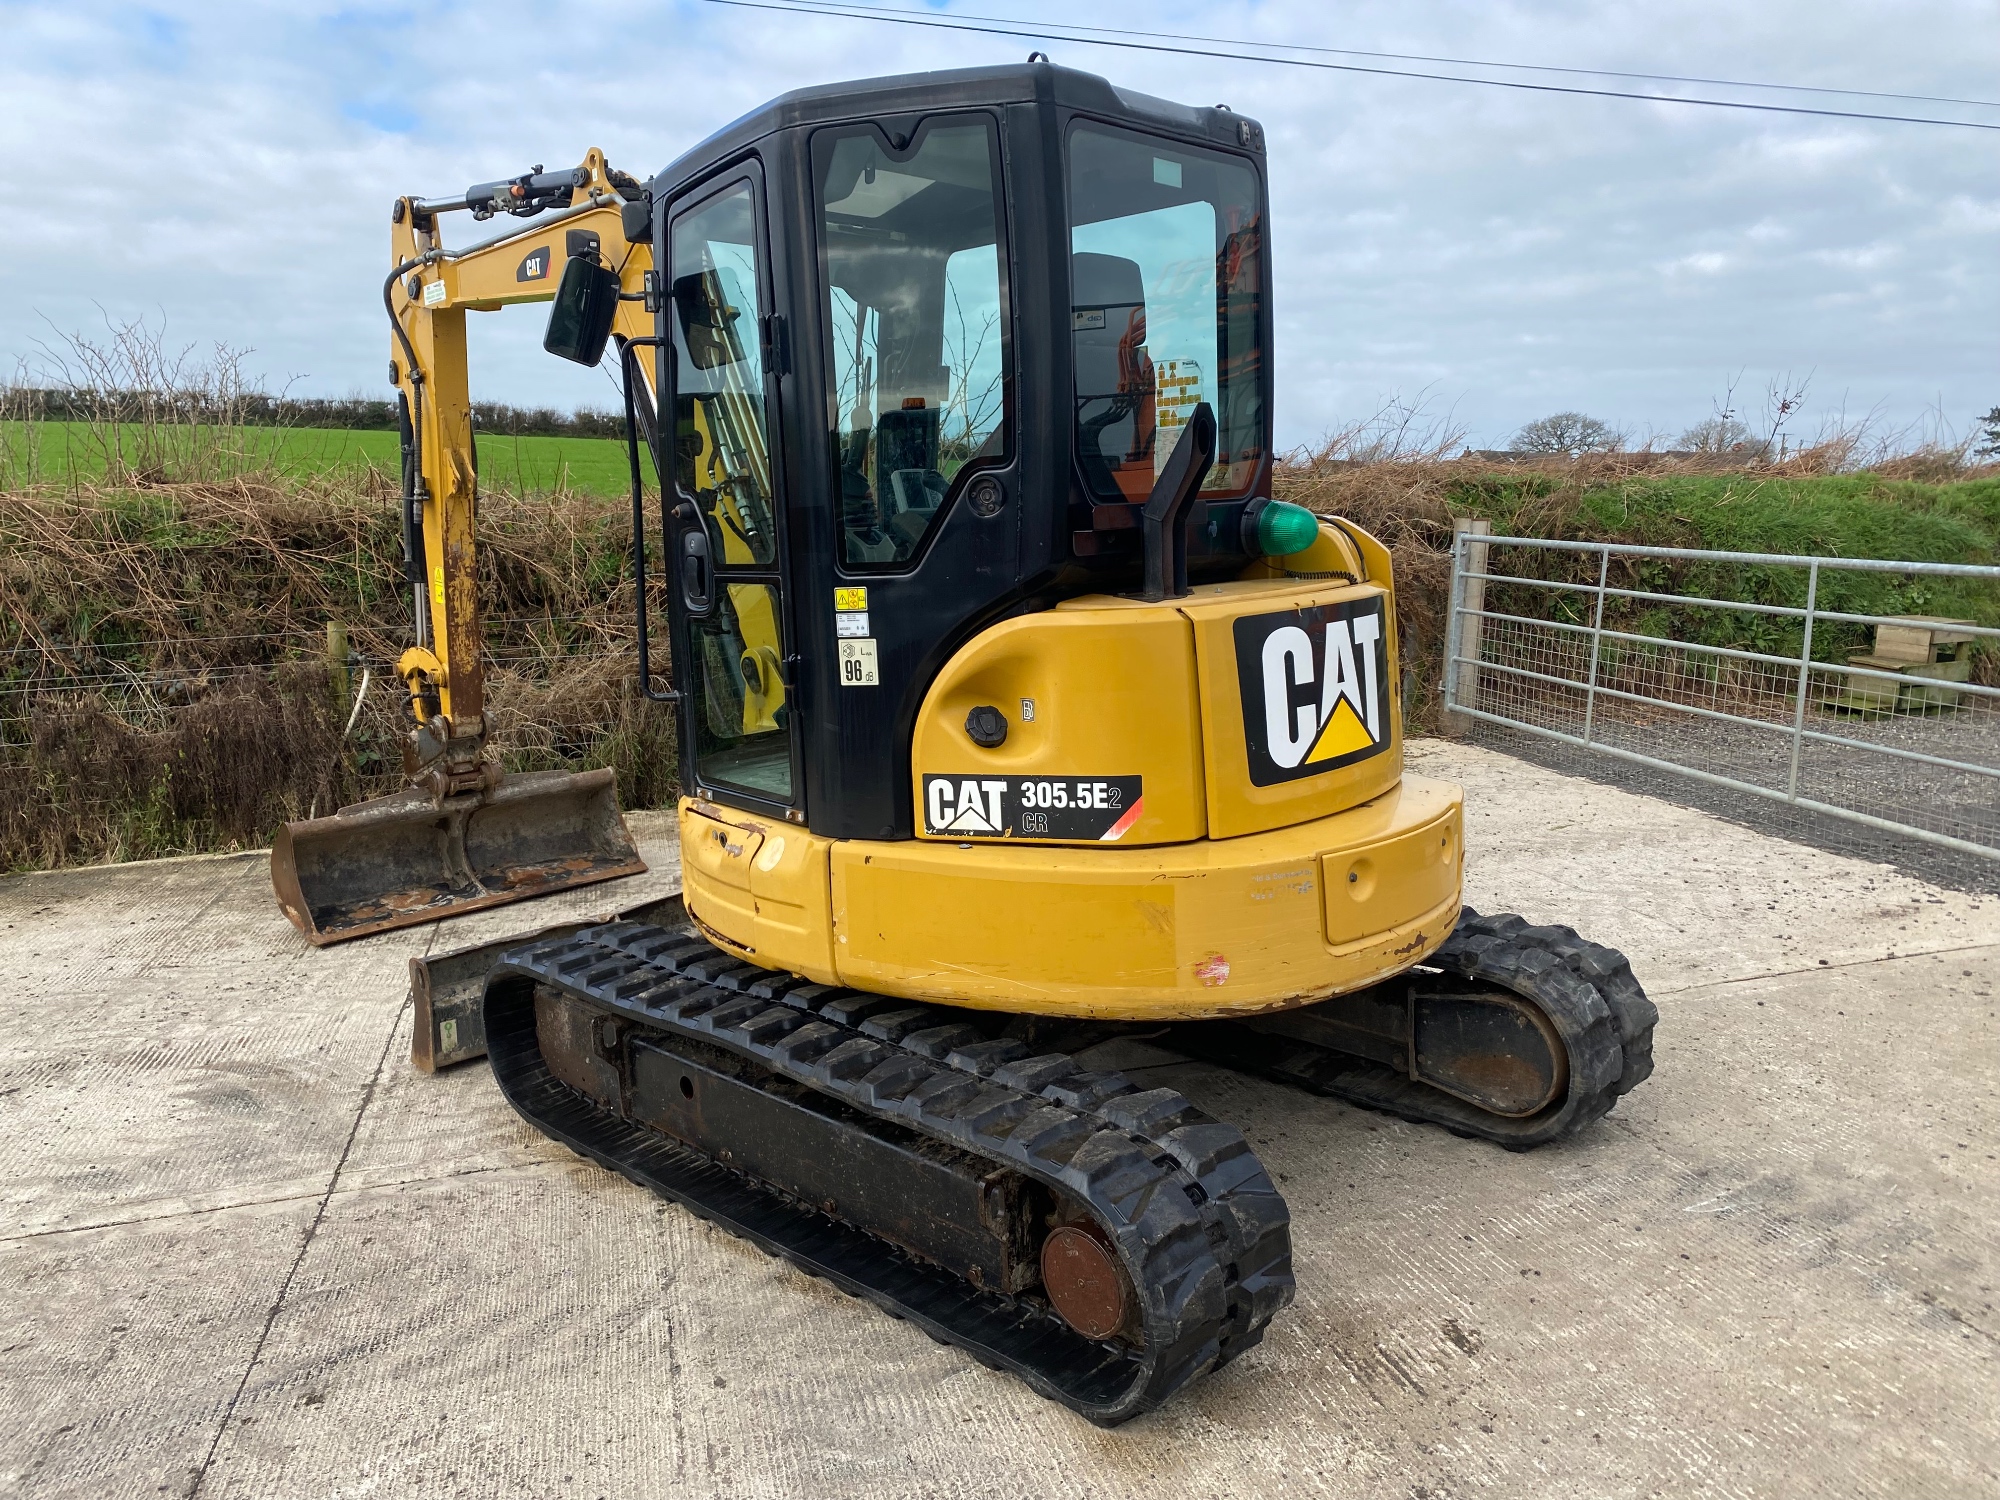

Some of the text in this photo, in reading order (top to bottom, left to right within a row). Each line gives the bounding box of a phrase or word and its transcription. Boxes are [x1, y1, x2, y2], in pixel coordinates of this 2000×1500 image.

[526, 257, 541, 276] CAT
[845, 660, 873, 681] 96 dB
[1261, 613, 1380, 769] CAT
[928, 778, 1008, 831] CAT
[1020, 781, 1122, 809] 305.5E2
[1021, 811, 1049, 833] CR
